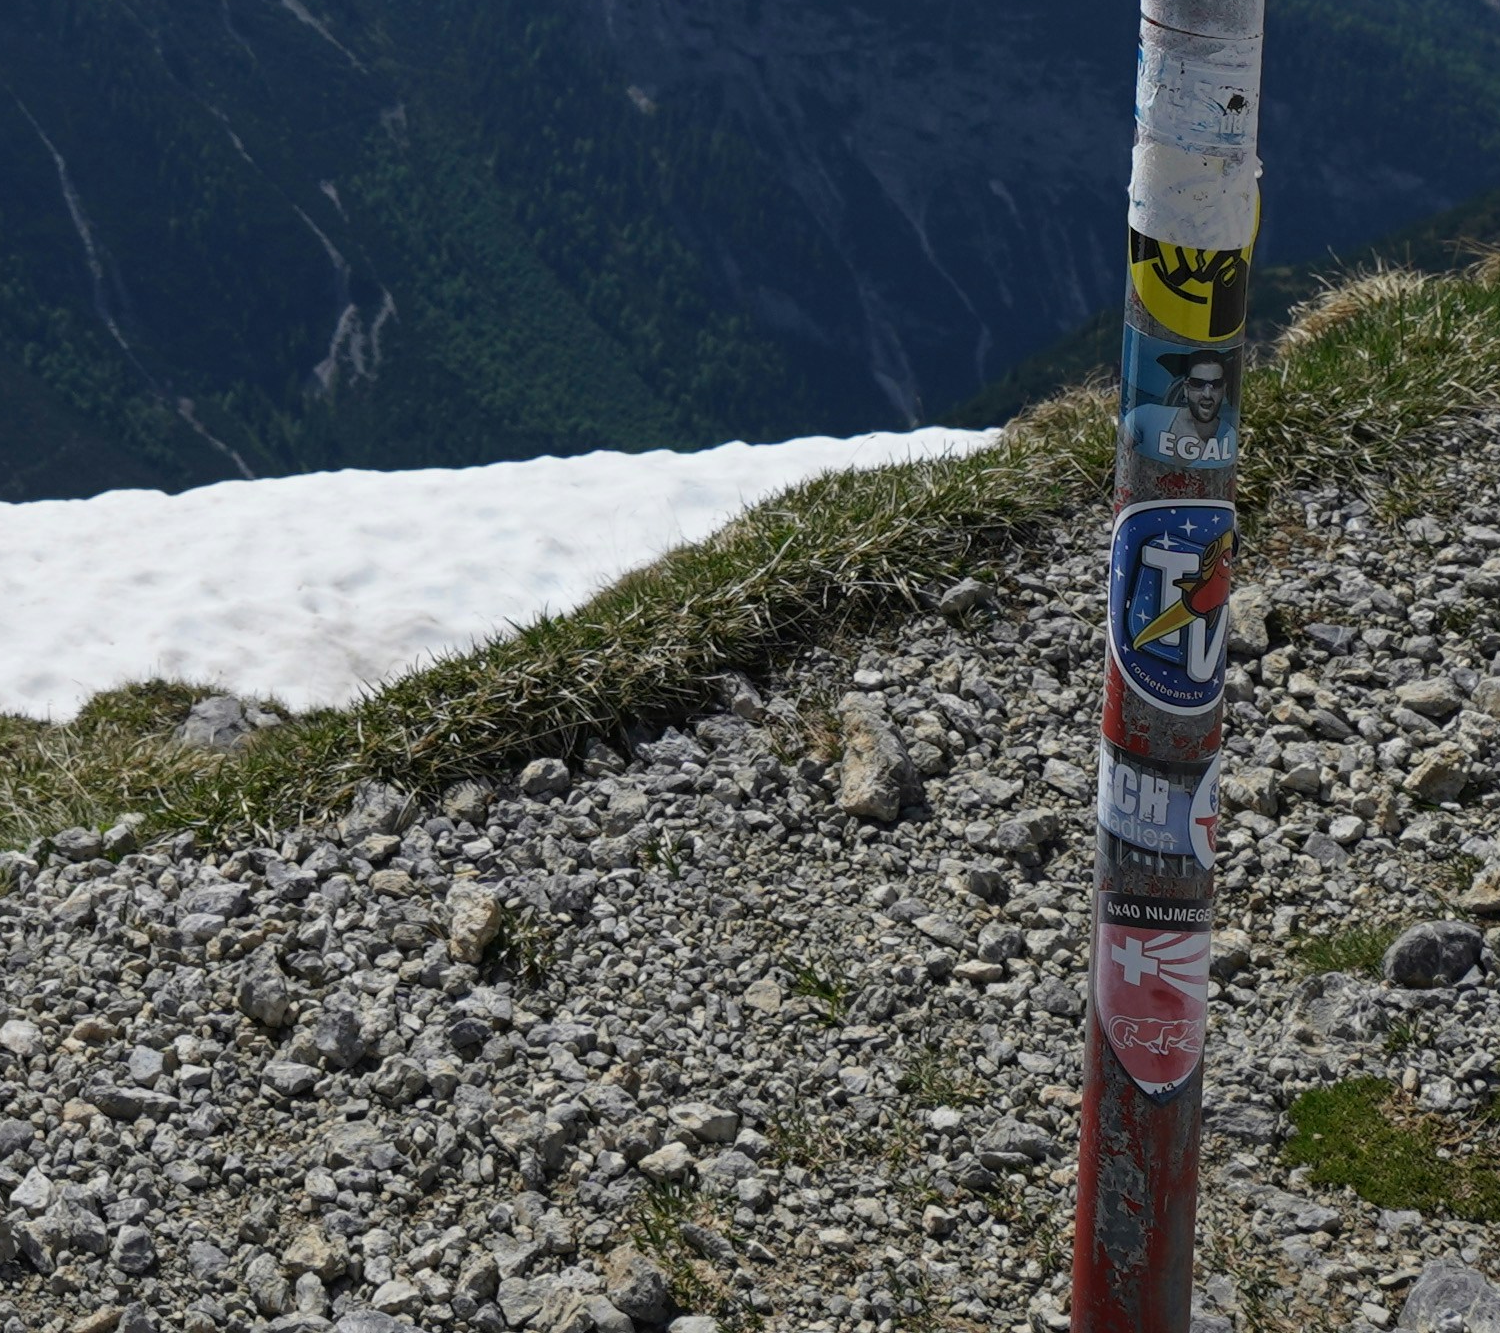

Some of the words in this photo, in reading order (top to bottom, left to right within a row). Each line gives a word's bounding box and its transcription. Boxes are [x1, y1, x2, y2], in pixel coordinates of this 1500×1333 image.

[1158, 430, 1232, 461] EGAL
[1130, 662, 1204, 700] rocketbeans.tv
[1107, 901, 1141, 919] 4x40
